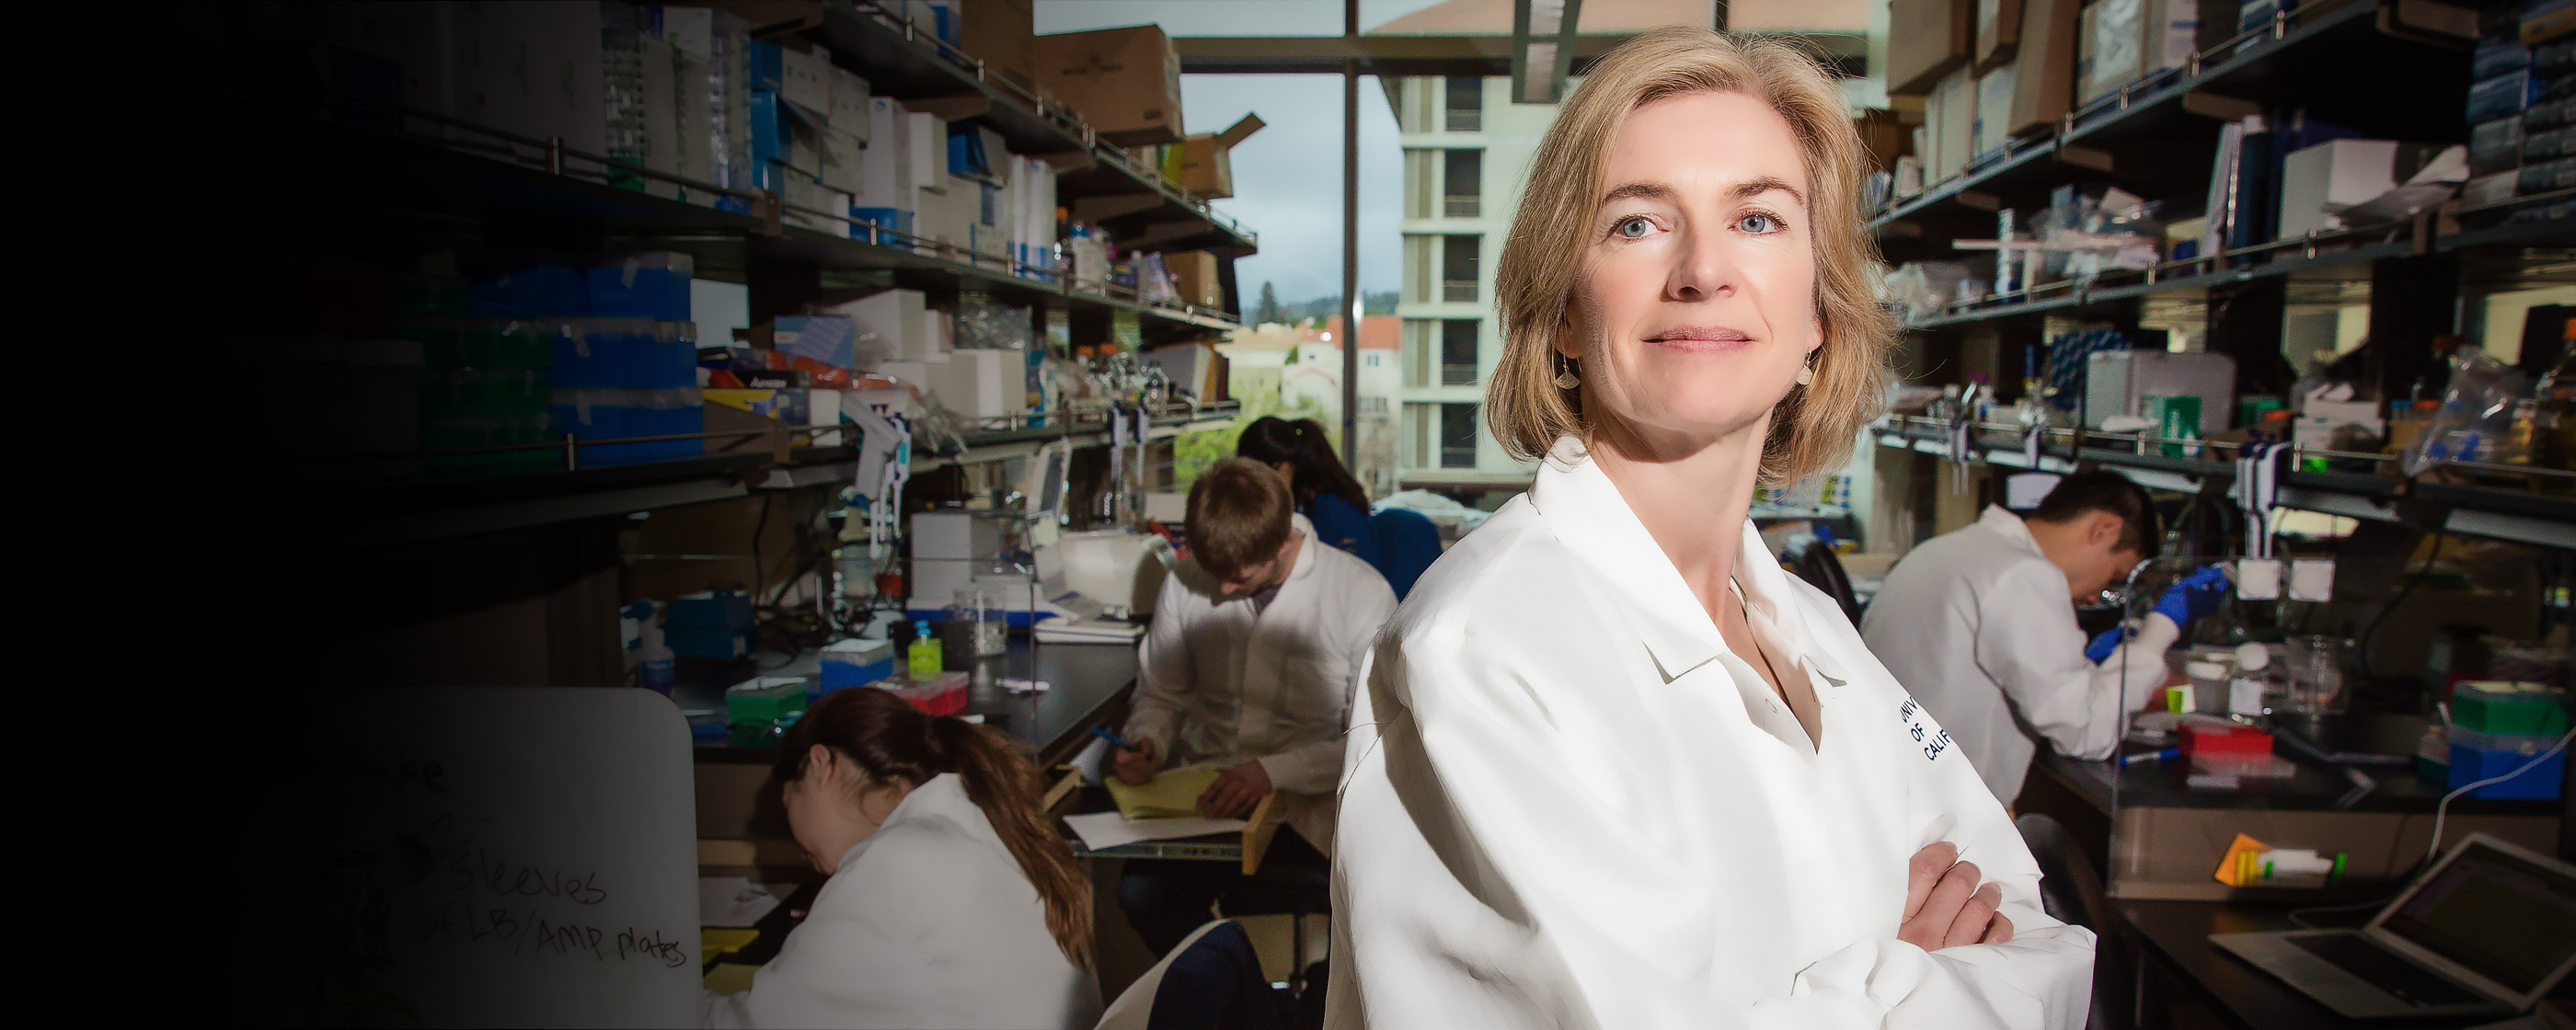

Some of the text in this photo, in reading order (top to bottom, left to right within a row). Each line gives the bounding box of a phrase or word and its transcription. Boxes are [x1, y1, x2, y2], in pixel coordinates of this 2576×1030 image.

[1910, 723, 1925, 742] OF
[1924, 728, 1950, 761] CALIF
[431, 813, 470, 860] 2
[417, 904, 456, 942] of
[617, 927, 688, 968] plates
